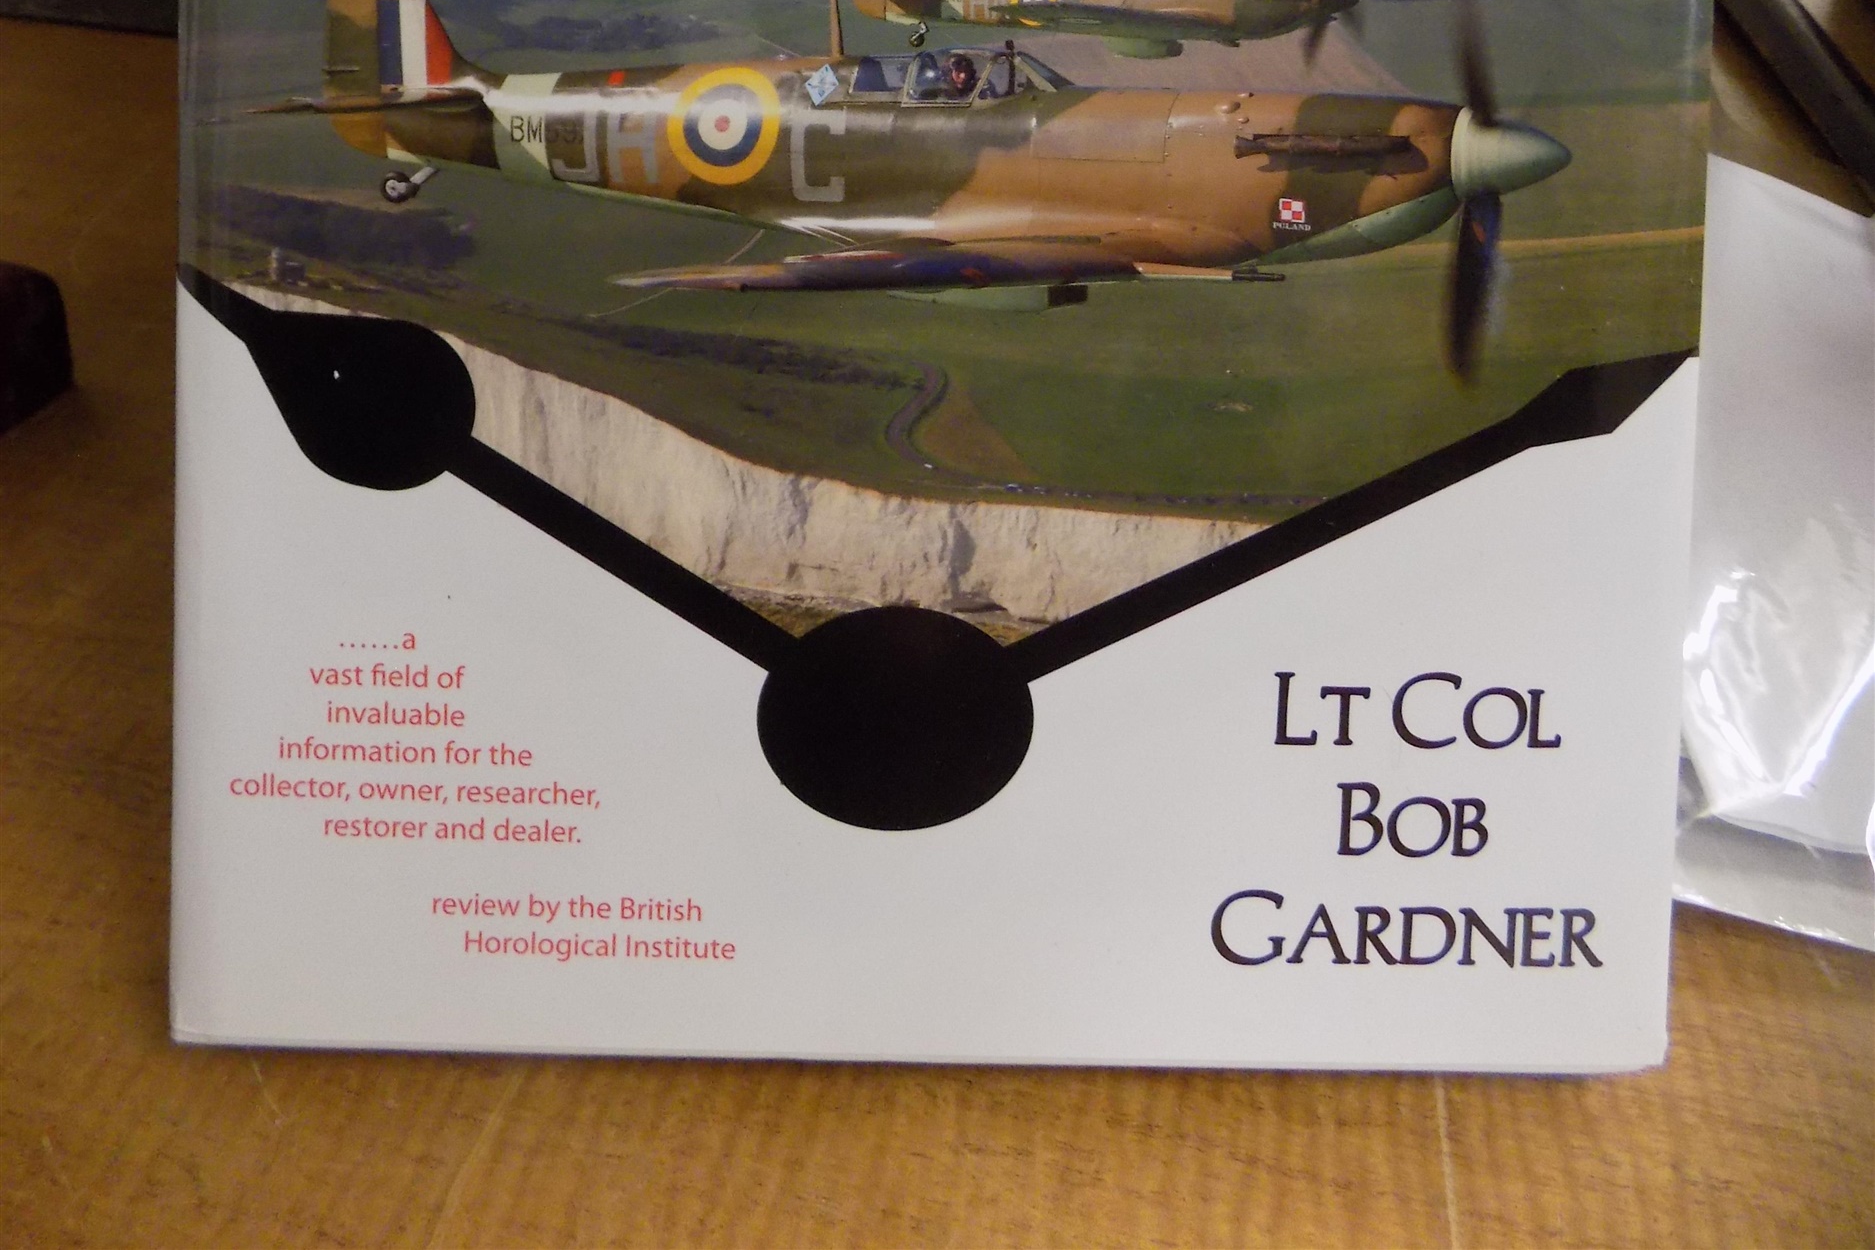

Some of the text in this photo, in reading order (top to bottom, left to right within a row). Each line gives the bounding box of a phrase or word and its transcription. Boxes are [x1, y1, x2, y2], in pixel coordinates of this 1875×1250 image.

[790, 108, 846, 202] C
[310, 662, 466, 688] vast field of
[327, 700, 465, 727] invaluable
[279, 736, 533, 767] information for the
[229, 772, 601, 809] collector, owner, researcher,
[324, 816, 581, 844] restorer and dealer.
[432, 892, 702, 924] review by the British
[464, 930, 736, 963] Horological Institute
